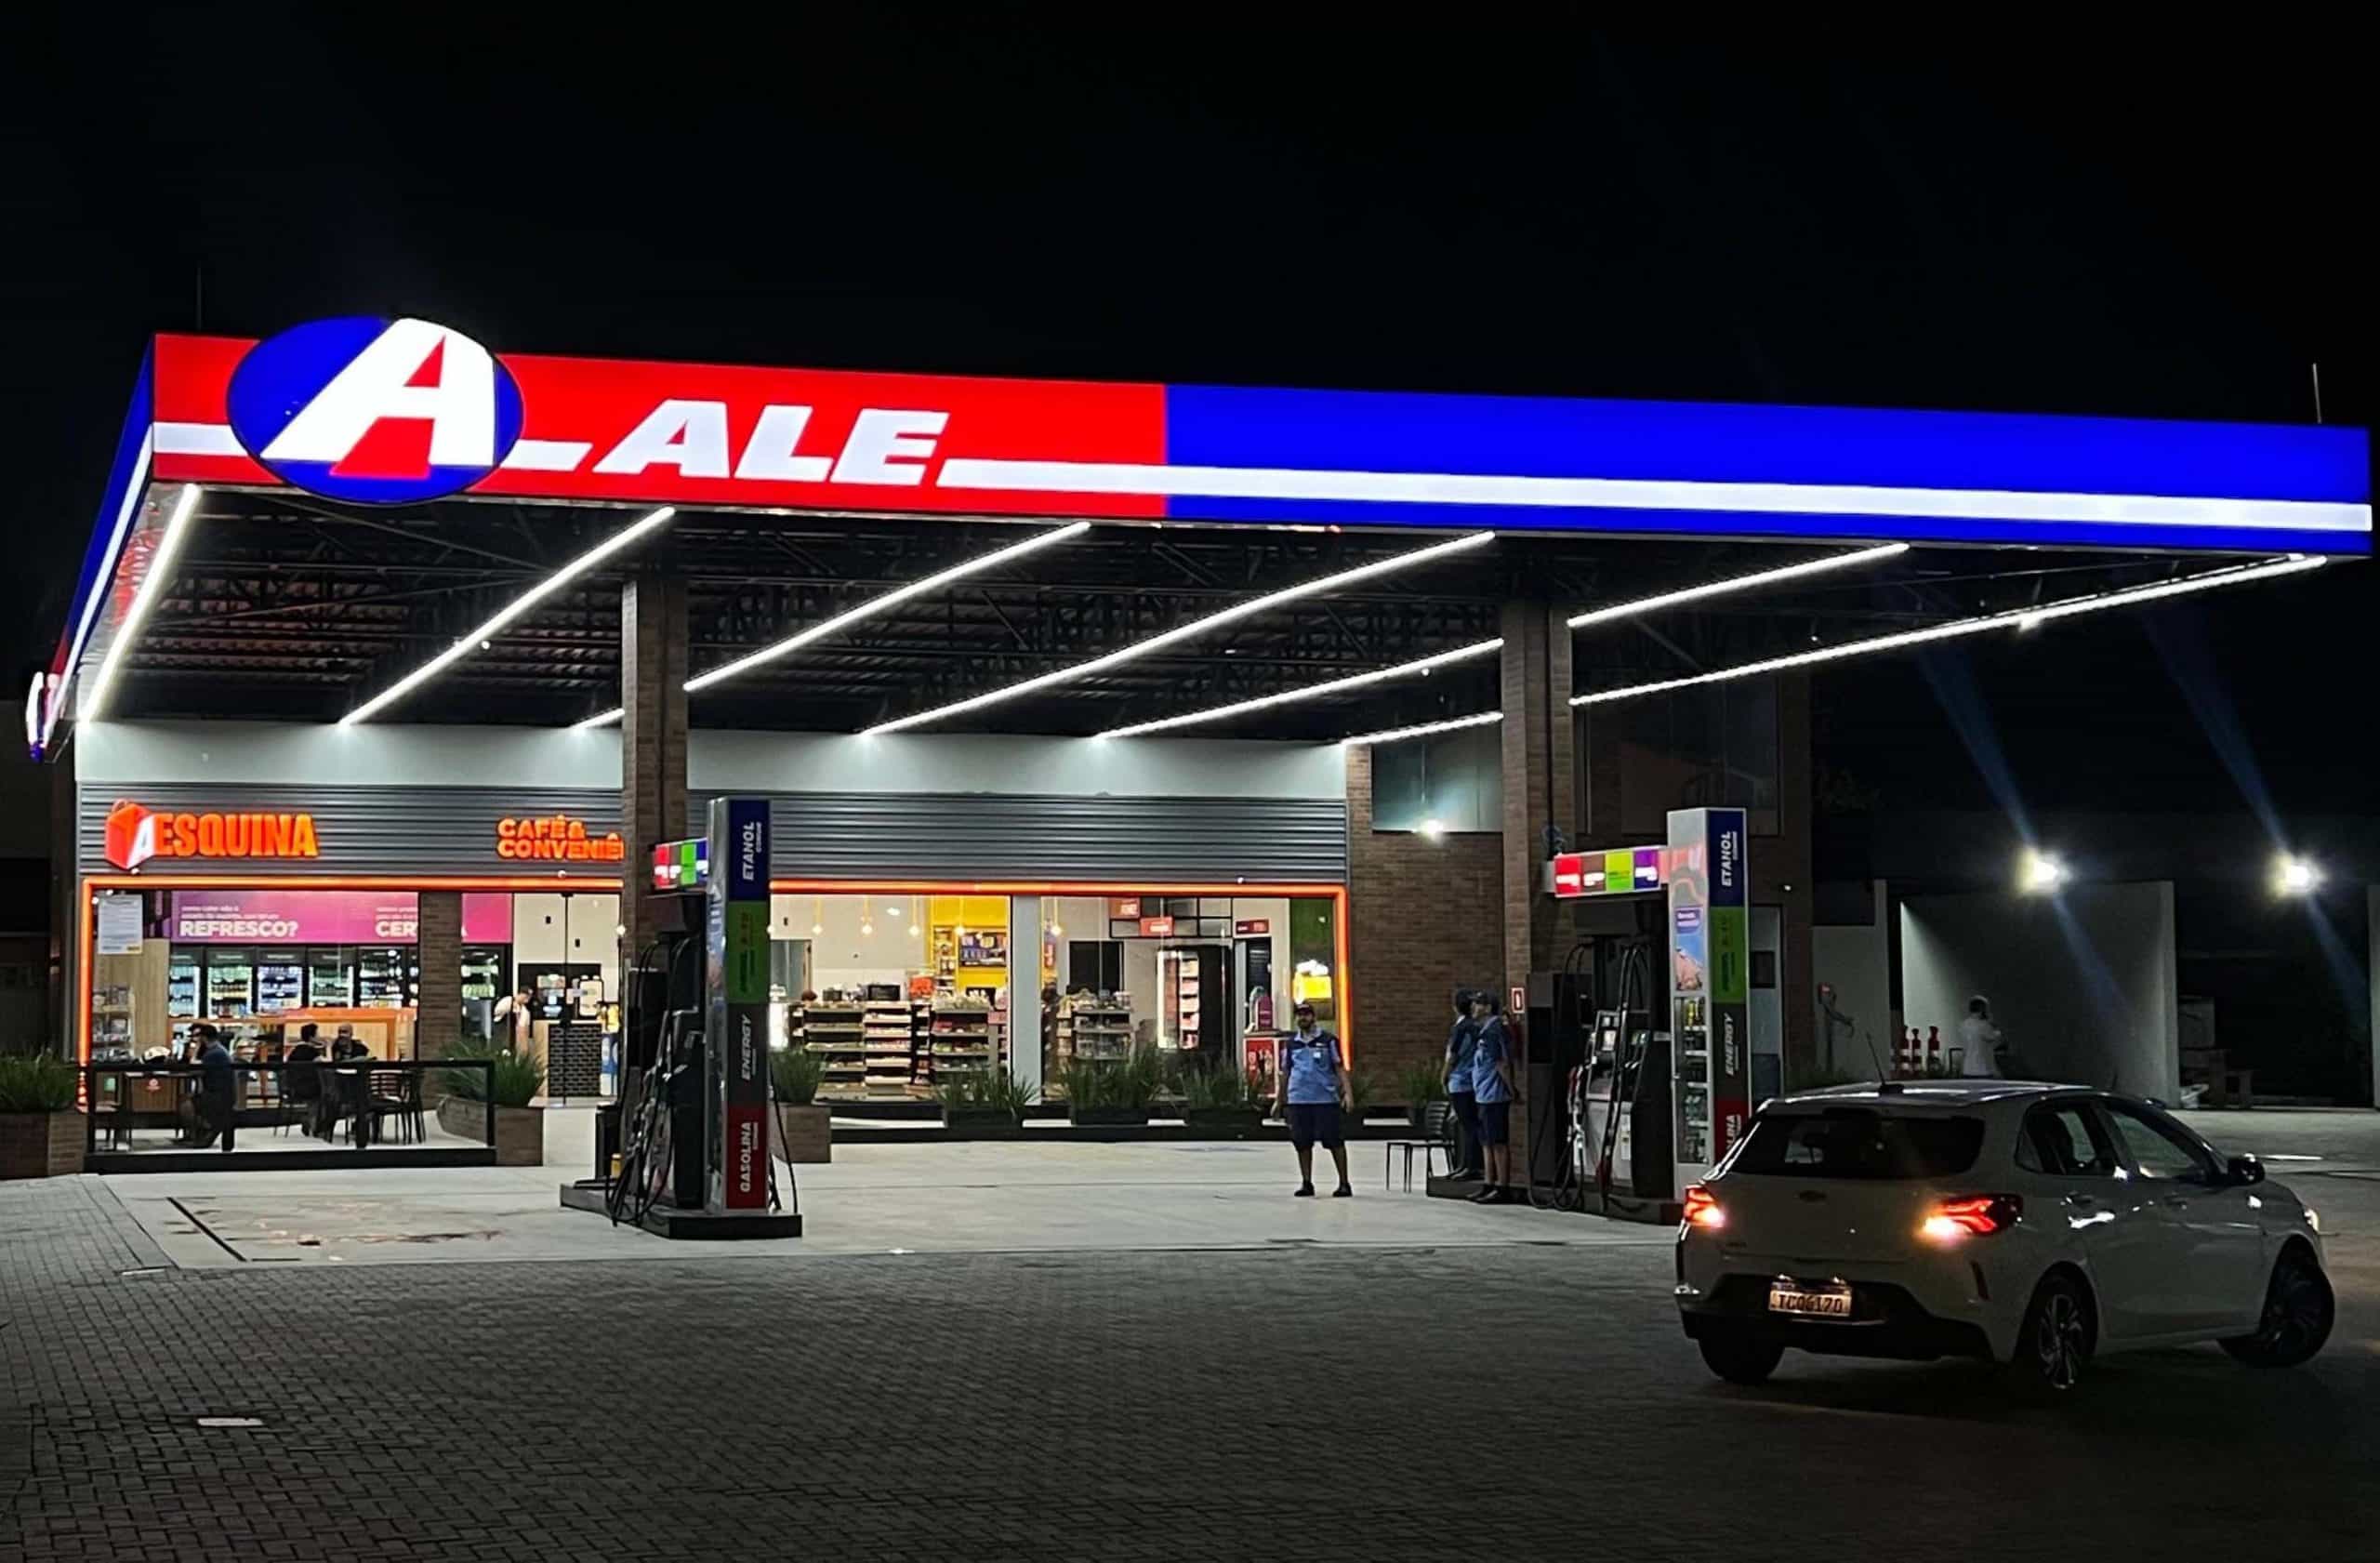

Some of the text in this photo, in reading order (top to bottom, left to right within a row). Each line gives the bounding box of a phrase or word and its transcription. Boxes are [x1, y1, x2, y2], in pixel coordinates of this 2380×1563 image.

[591, 398, 950, 486] ALE
[154, 813, 319, 857] ESQUINA
[743, 821, 755, 881] ETANOL
[1720, 830, 1732, 886] ETANOL
[179, 921, 298, 937] REFRESCO?
[375, 921, 418, 937] CER
[741, 1013, 751, 1080] ENERGY
[1724, 1012, 1734, 1076] ENERGY
[740, 1121, 751, 1193] GASOLINA
